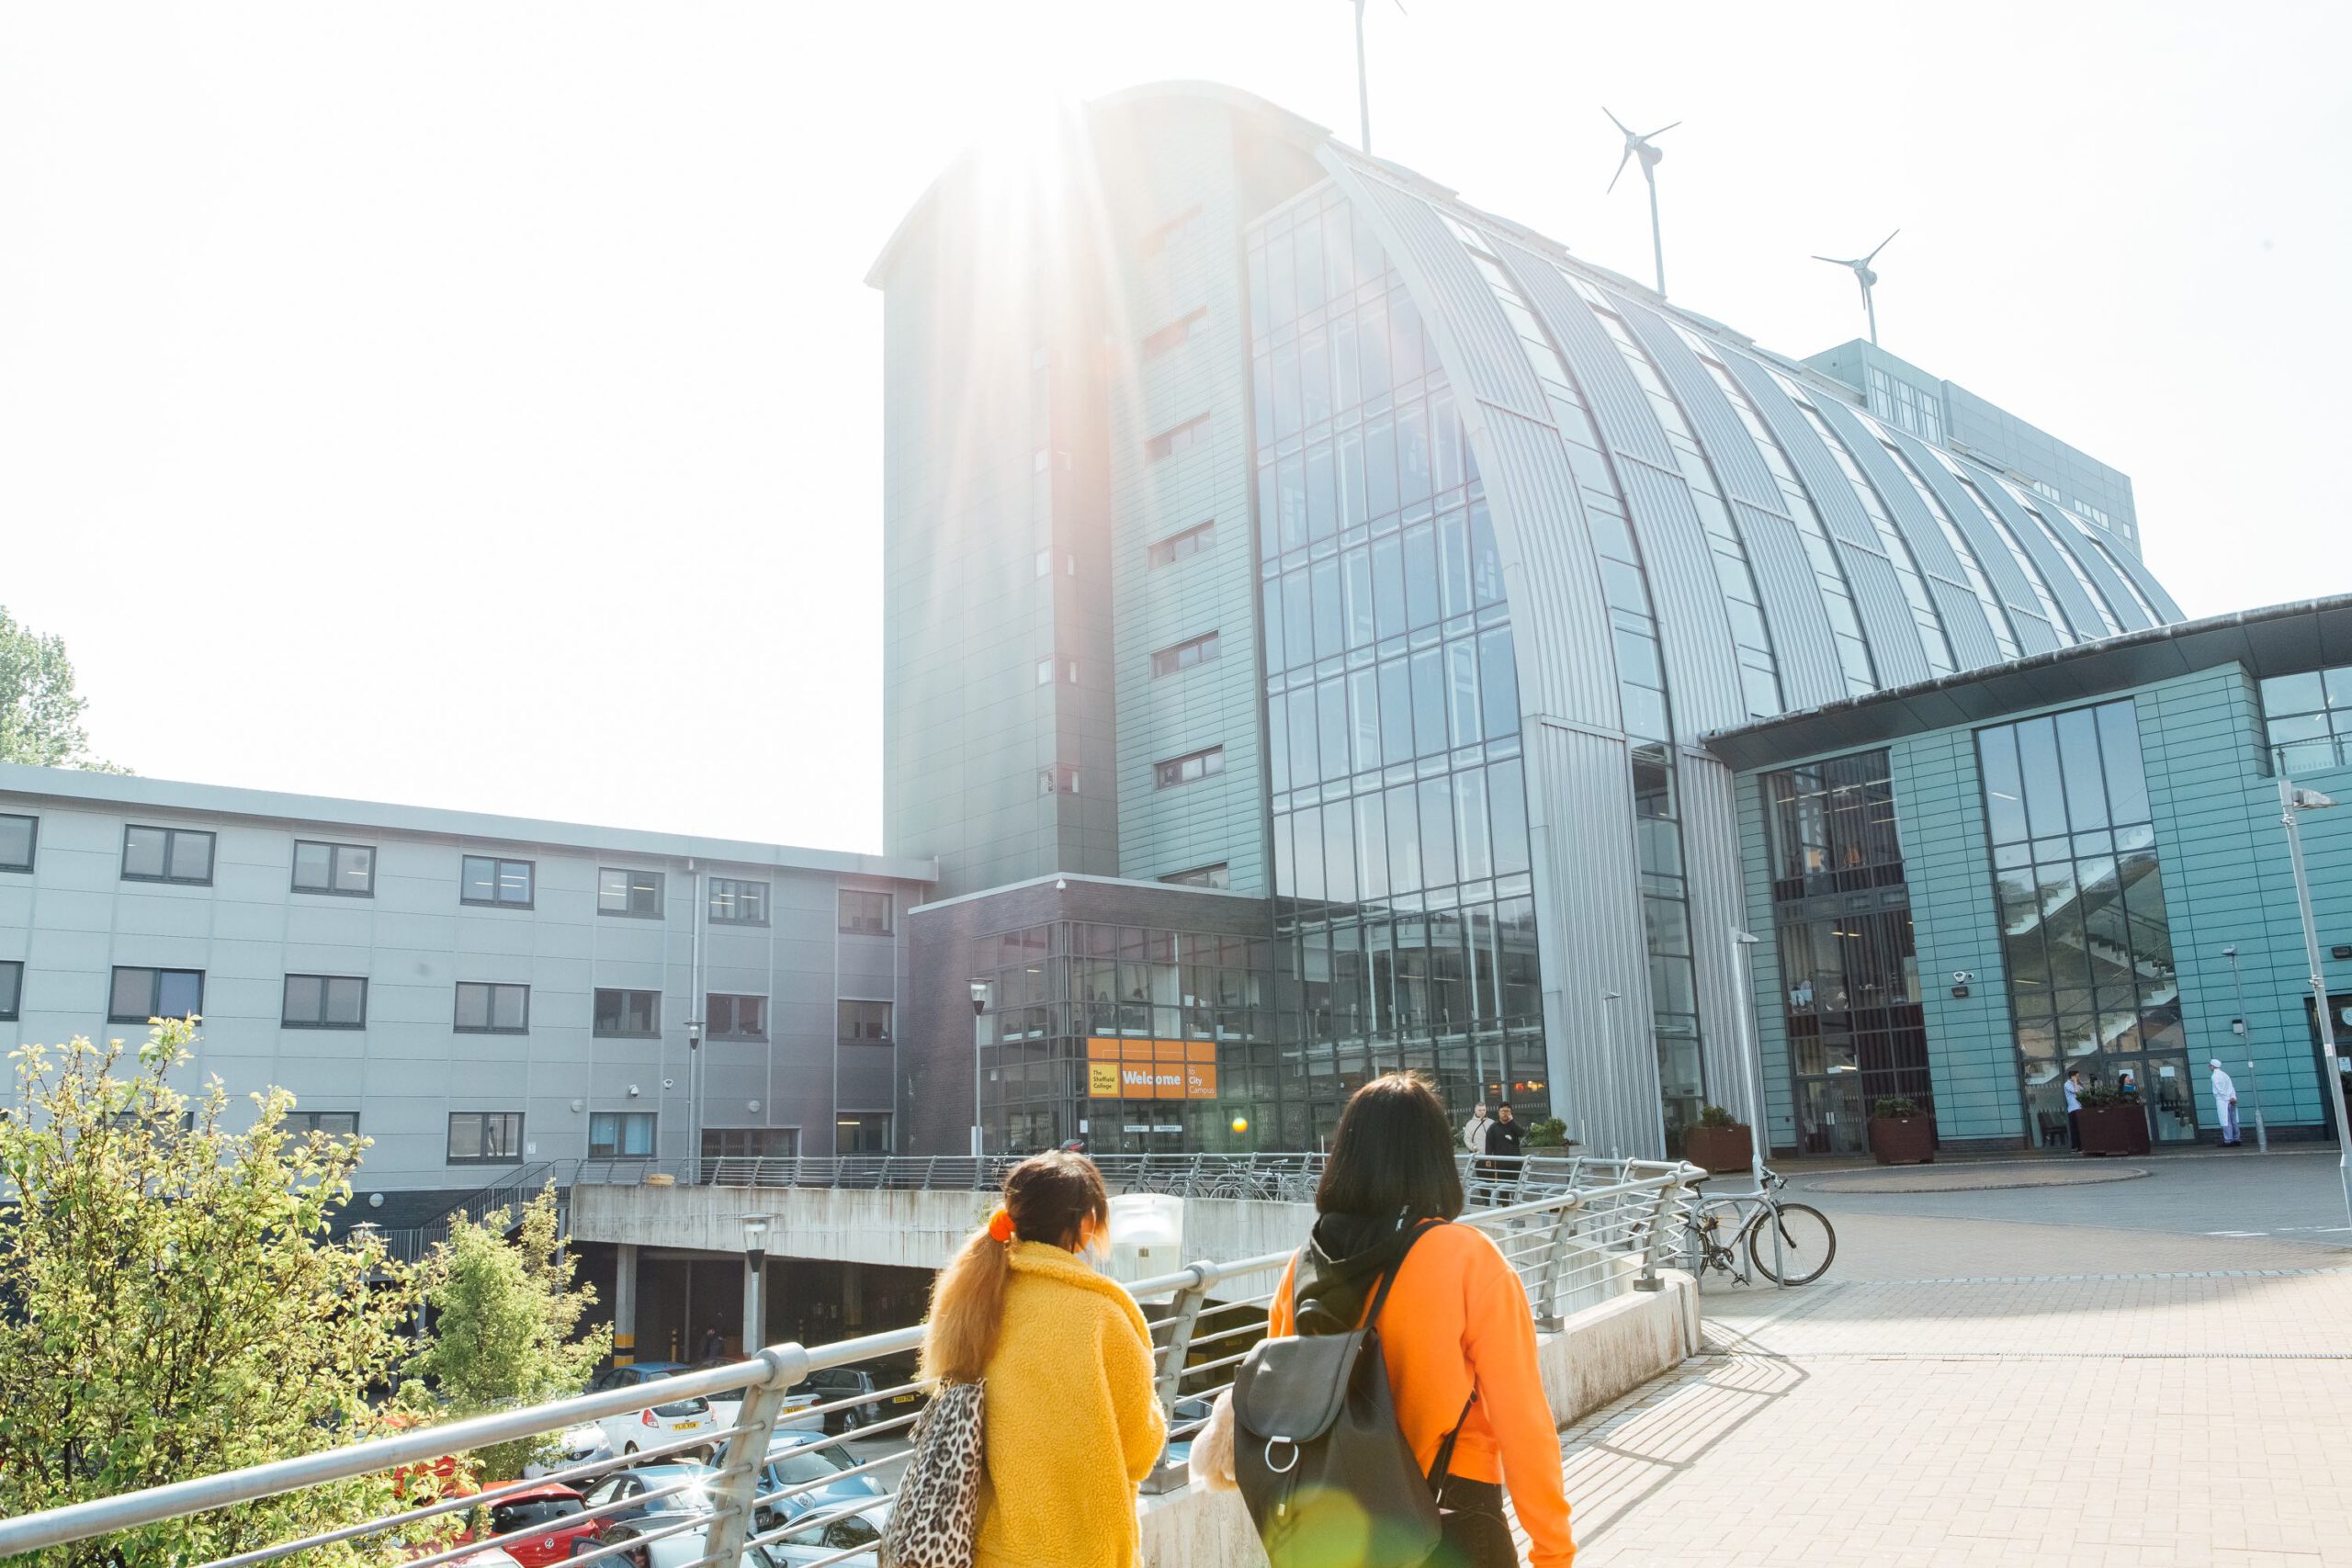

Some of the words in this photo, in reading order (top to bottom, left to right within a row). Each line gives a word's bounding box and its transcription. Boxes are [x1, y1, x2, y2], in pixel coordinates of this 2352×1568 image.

[1122, 1070, 1181, 1085] Welcome
[1189, 1076, 1203, 1086] City
[1189, 1086, 1215, 1095] Campus
